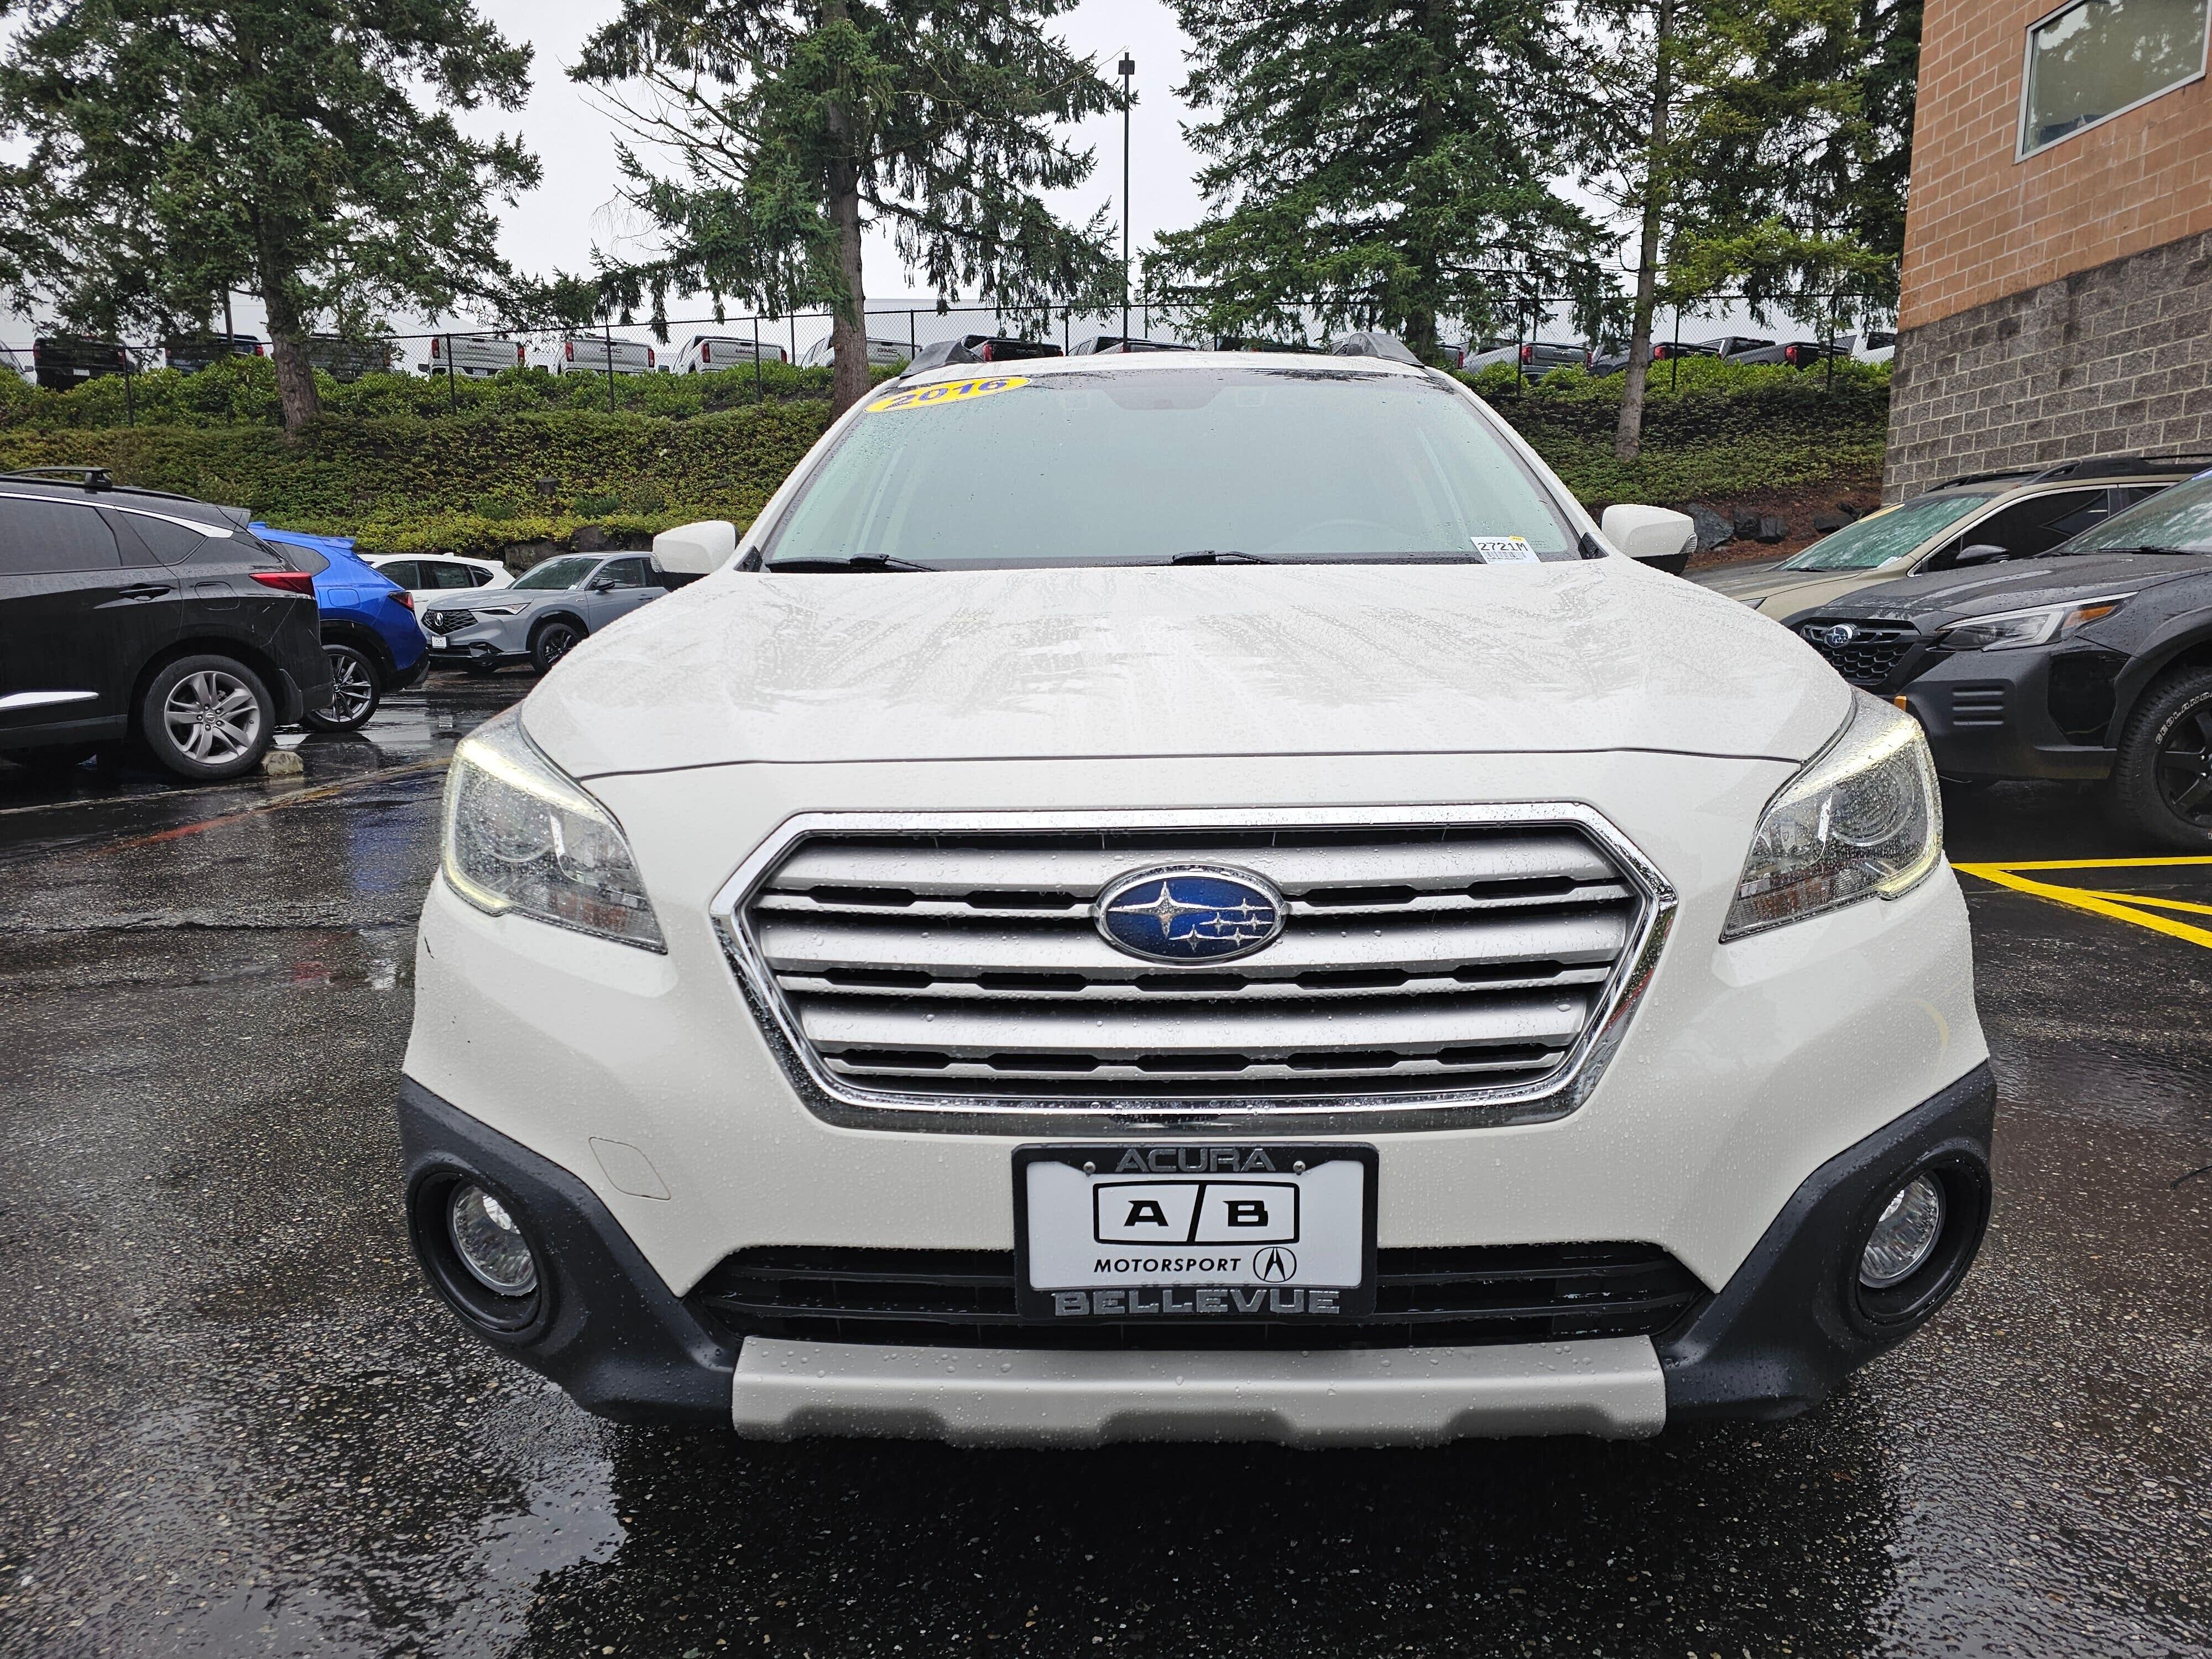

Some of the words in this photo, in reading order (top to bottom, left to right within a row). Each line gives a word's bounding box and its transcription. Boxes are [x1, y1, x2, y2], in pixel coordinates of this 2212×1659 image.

[883, 379, 1009, 410] 2016
[1477, 542, 1529, 551] 2721M
[2155, 691, 2212, 745] GEOLAND
[1114, 1147, 1276, 1173] ACURA
[1123, 1200, 1170, 1227] A
[1222, 1200, 1269, 1227] B
[1094, 1258, 1241, 1272] MOTORSPORT
[1051, 1289, 1340, 1317] BELLEVUE
